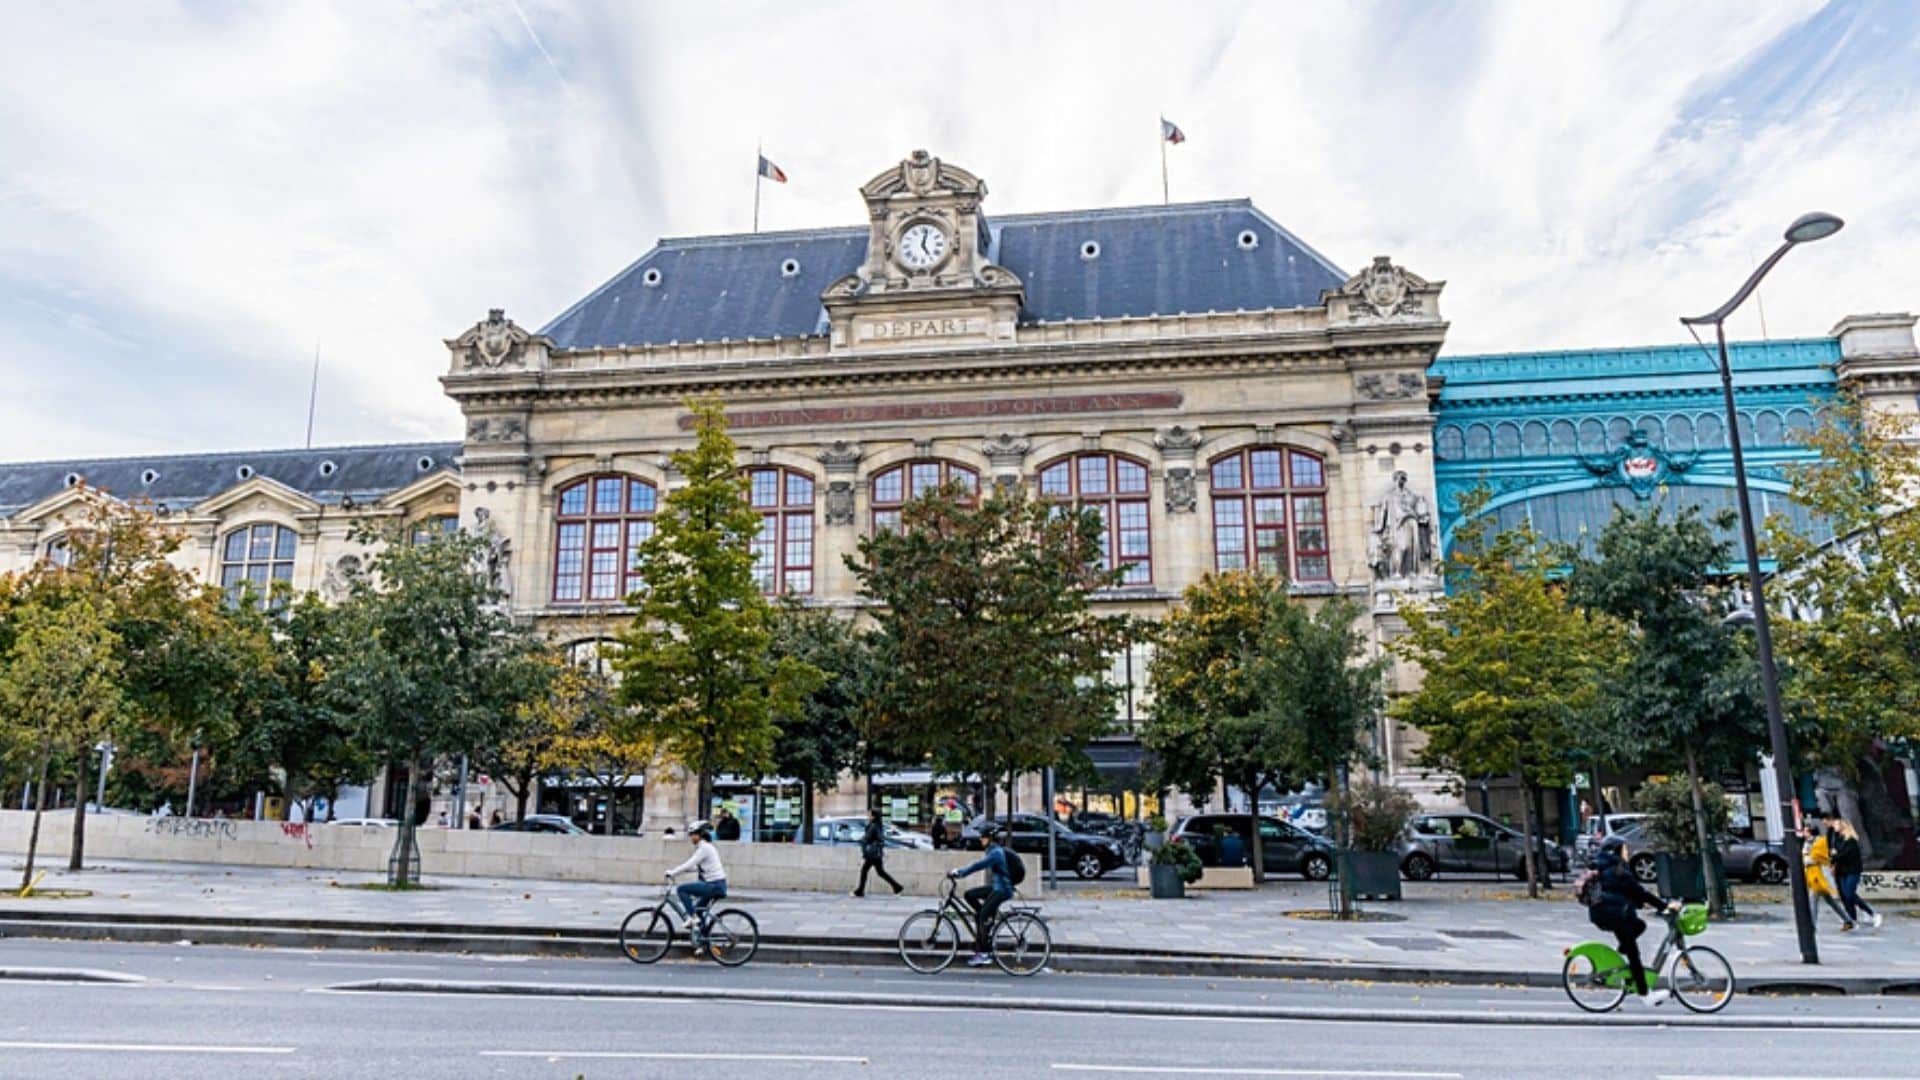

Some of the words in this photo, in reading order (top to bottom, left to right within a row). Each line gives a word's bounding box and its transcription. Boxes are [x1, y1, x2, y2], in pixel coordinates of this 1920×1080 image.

[873, 319, 969, 337] DEPART
[716, 408, 813, 427] HEMIN
[983, 393, 1144, 413] DORLEANS
